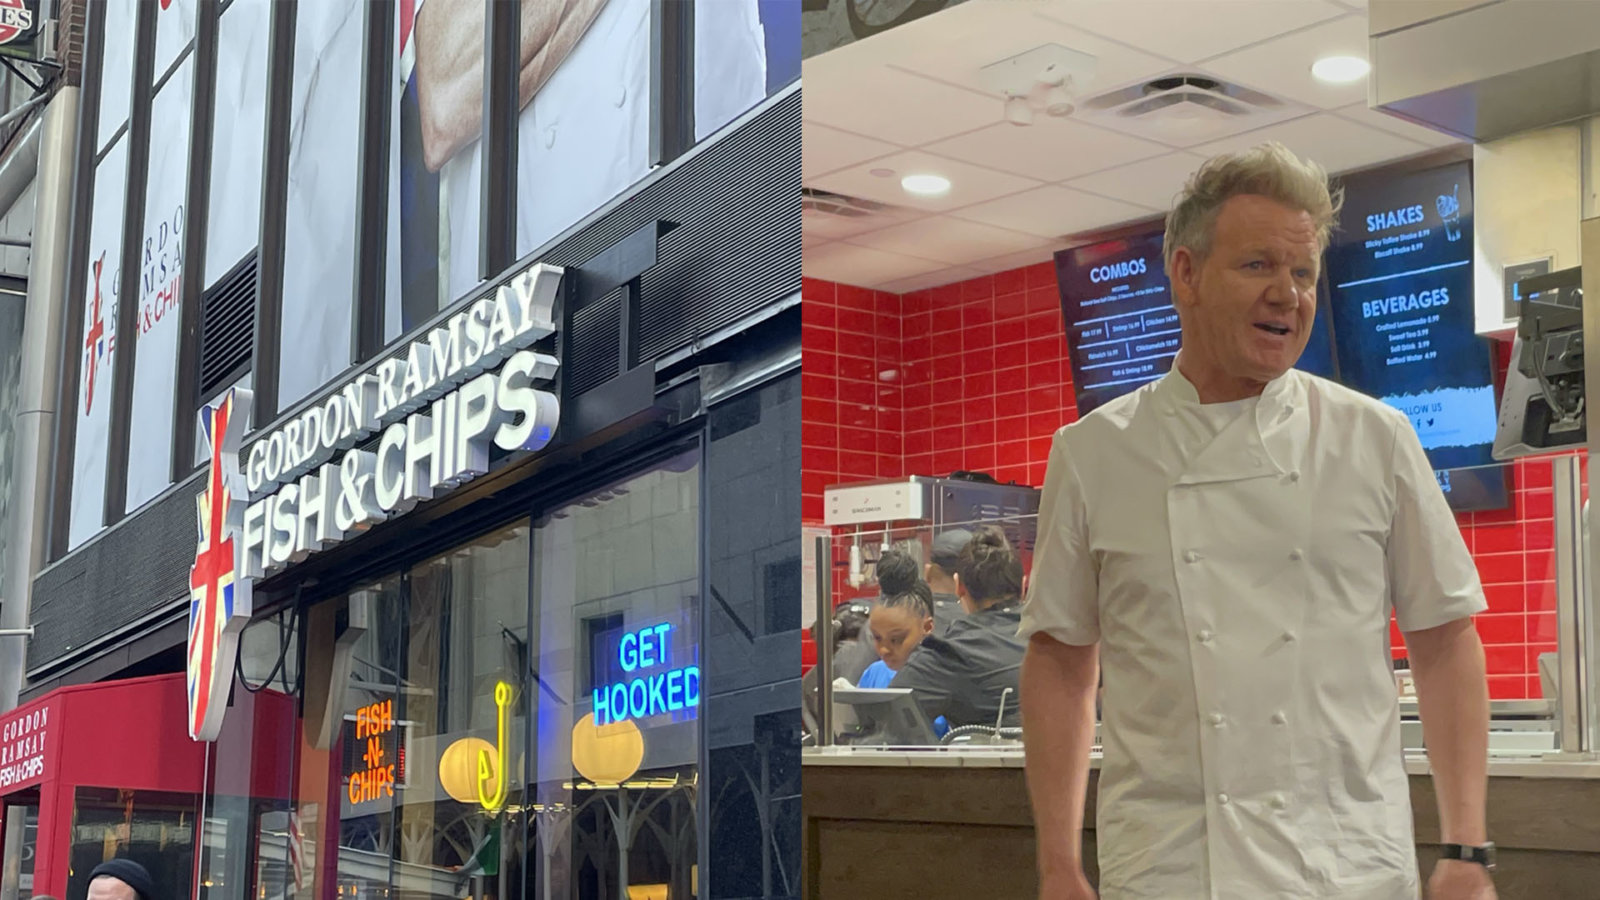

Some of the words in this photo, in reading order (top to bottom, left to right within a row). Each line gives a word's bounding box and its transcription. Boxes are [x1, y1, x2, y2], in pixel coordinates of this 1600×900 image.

[1366, 204, 1424, 232] SHAKES
[1090, 258, 1147, 283] COMBOS
[1362, 287, 1449, 318] BEVERAGES
[247, 374, 374, 492] GORDON
[375, 263, 558, 420] RAMSAY
[1399, 404, 1428, 416] OLLOW
[1431, 402, 1442, 412] US
[241, 463, 338, 579] FISH
[335, 448, 378, 532] &
[375, 350, 560, 511] CHIPS
[619, 622, 671, 672] GET
[593, 666, 700, 727] HOOKED
[3, 706, 49, 743] GORDON
[356, 698, 392, 740] FISH
[1, 730, 47, 766] RAMSAY
[0, 764, 16, 788] FISH
[21, 754, 44, 780] CHIPS
[348, 763, 395, 805] CHIPS
